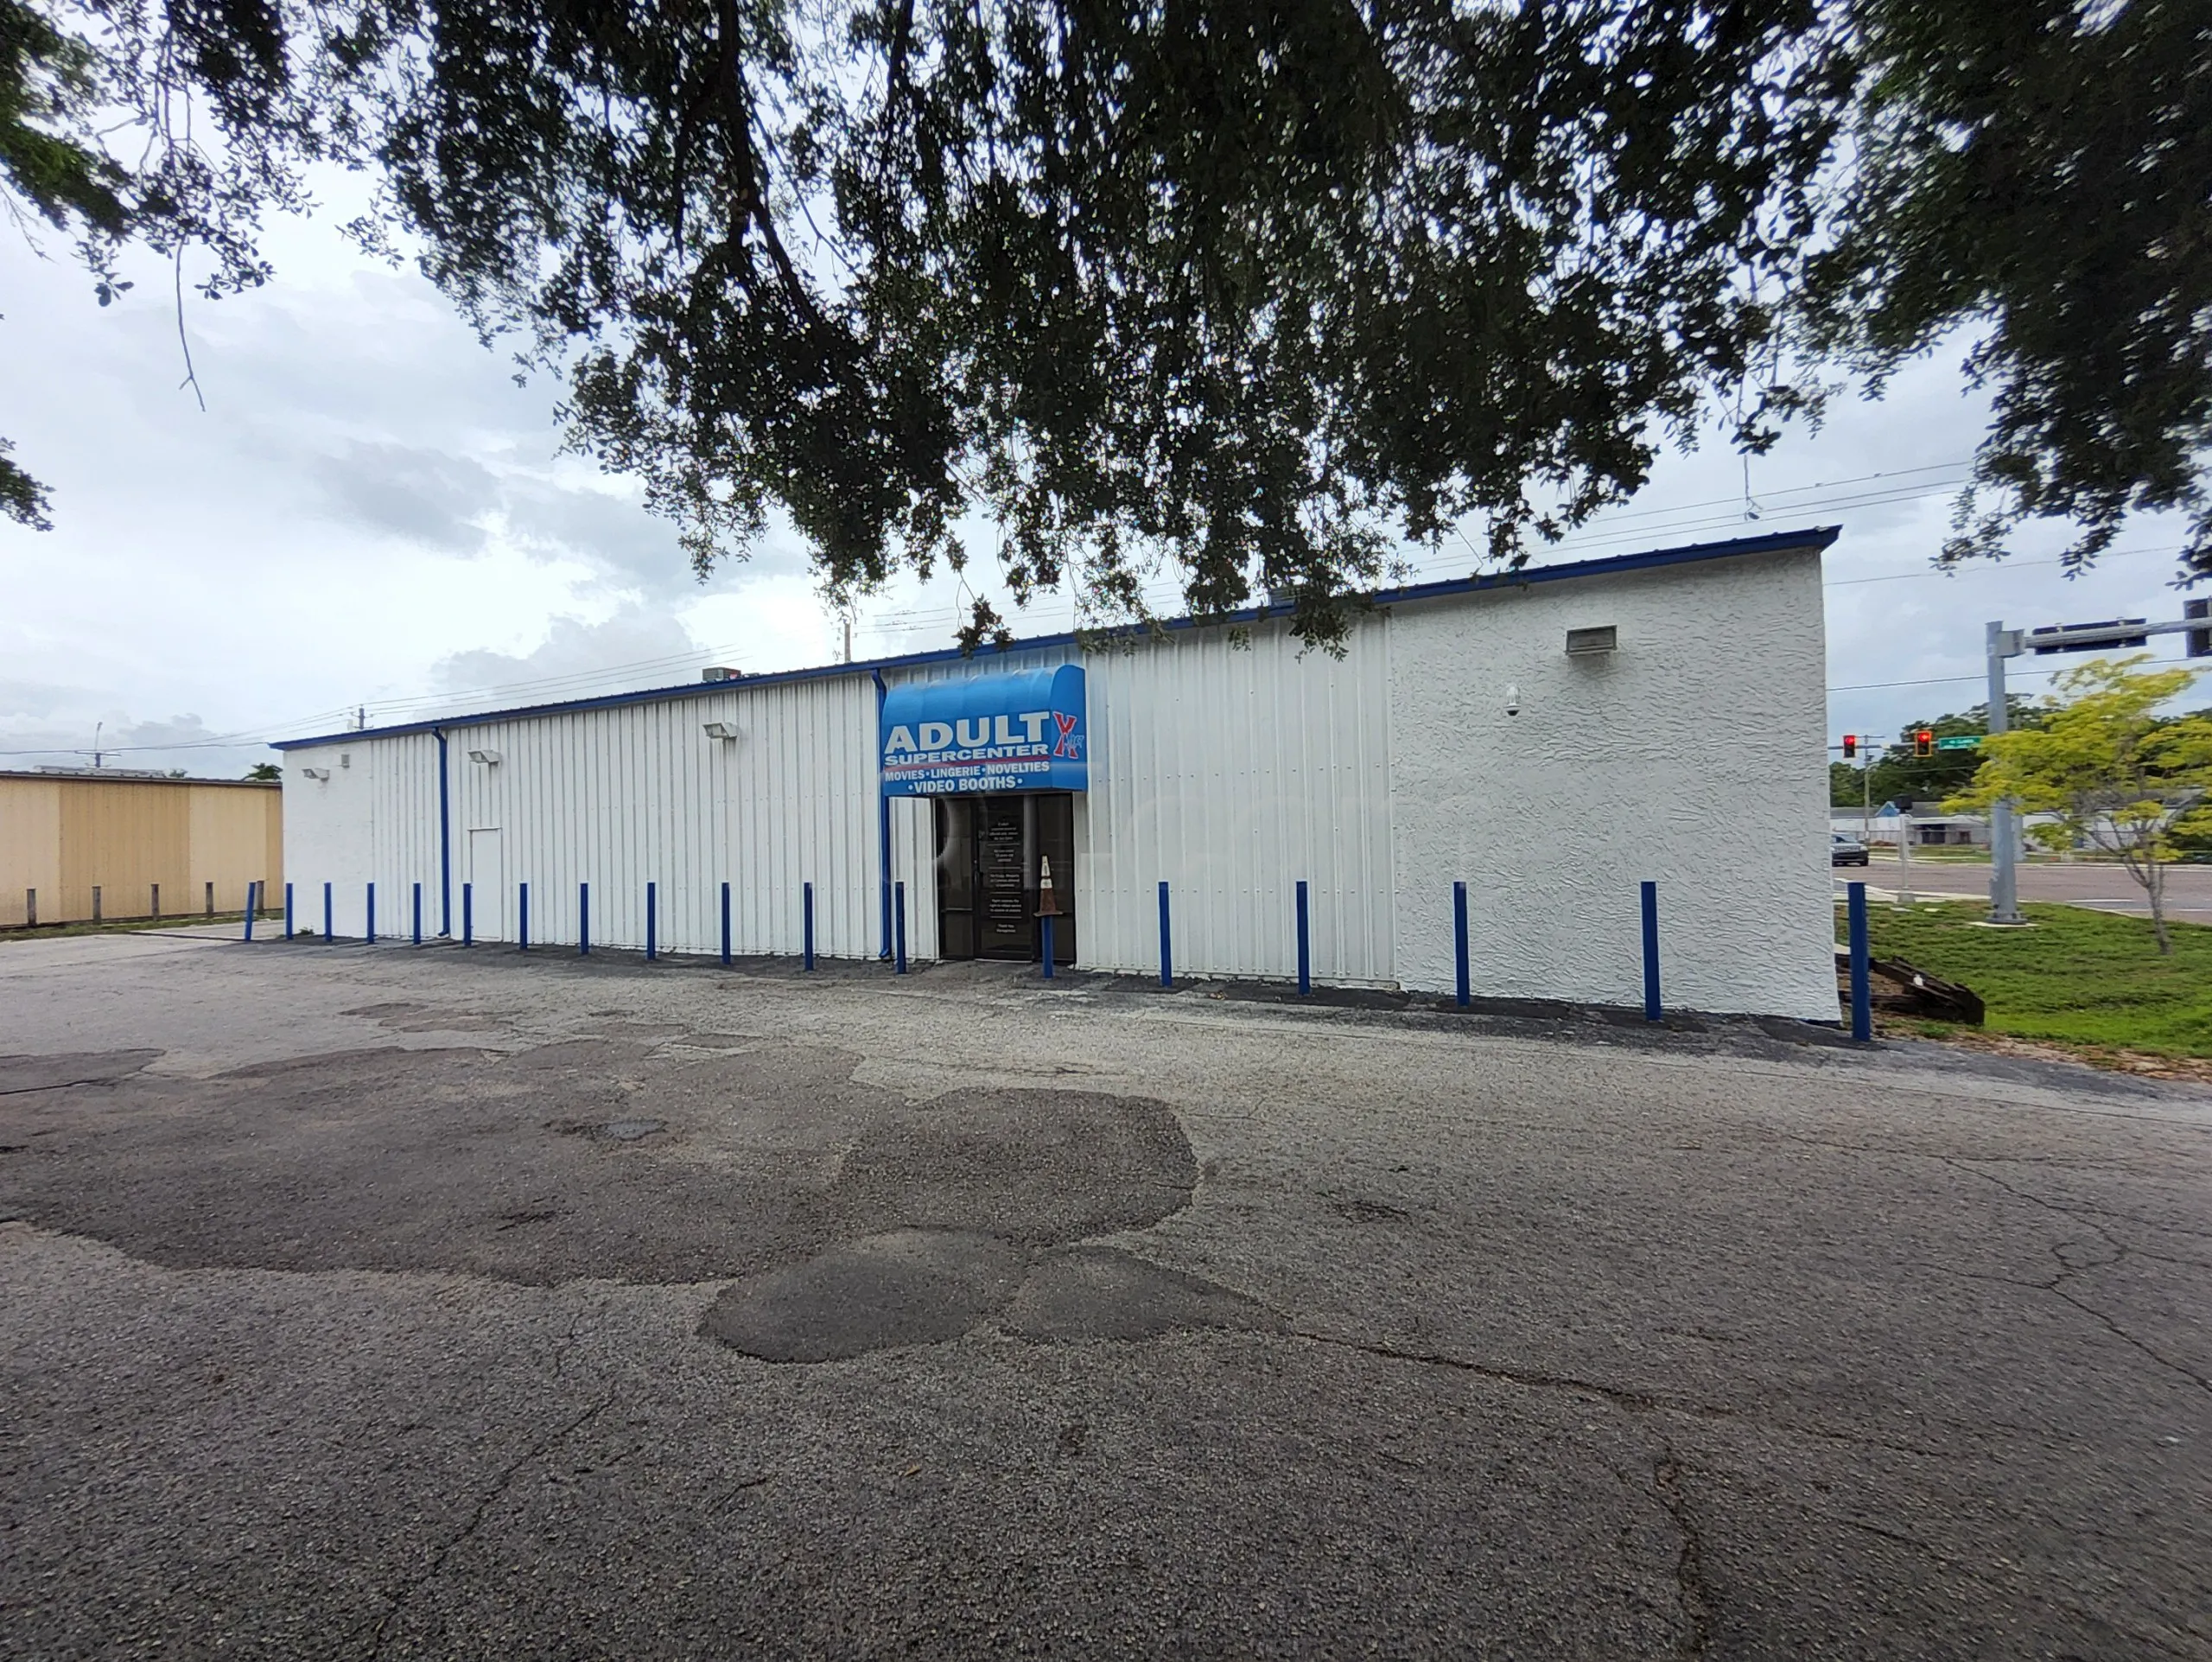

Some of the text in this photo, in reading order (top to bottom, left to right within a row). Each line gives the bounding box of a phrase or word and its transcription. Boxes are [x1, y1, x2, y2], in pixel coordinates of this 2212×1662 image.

[884, 711, 1050, 755] ADULT
[884, 744, 1049, 767] SUPERCENTER
[885, 761, 1050, 782] MOVIES LINGERIE NOVELTIES
[914, 776, 1016, 793] VIDEO BOOTHS
